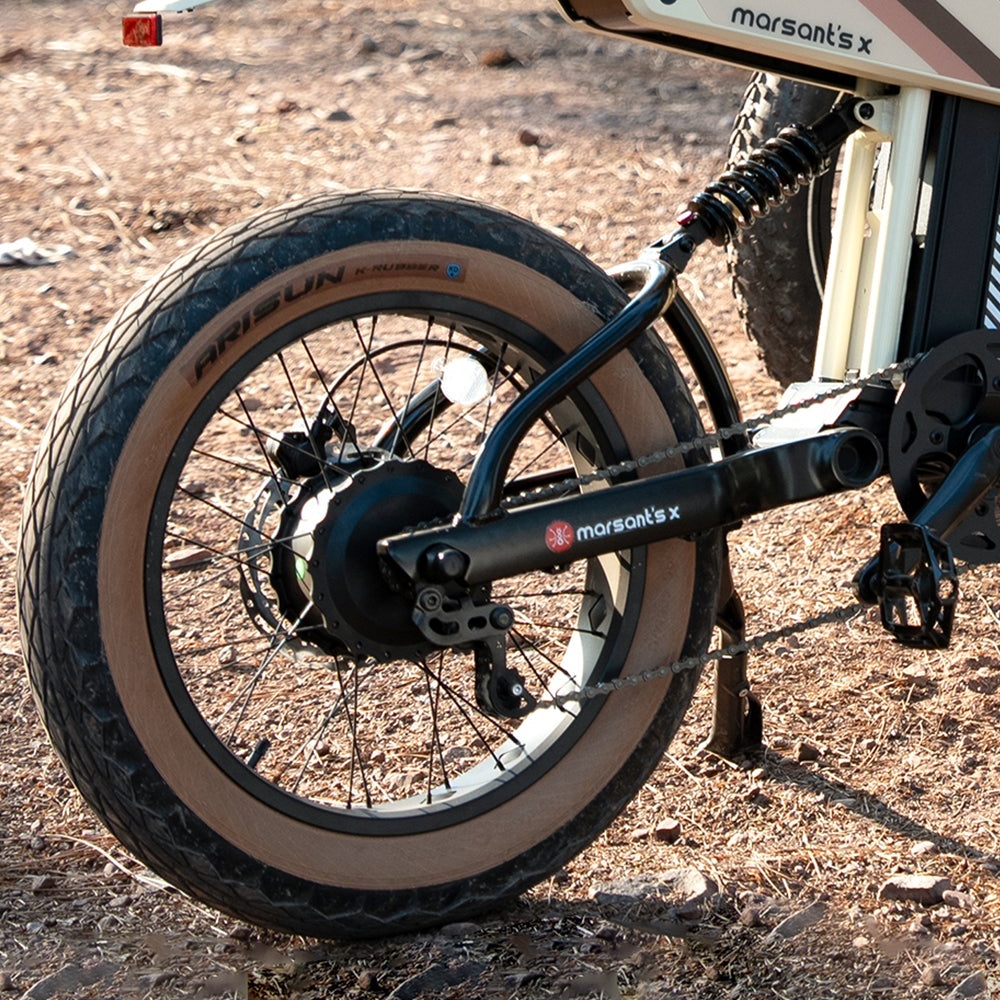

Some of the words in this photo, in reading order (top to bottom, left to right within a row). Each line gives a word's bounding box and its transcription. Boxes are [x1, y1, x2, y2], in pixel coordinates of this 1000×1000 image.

[731, 7, 853, 50] marsant's
[195, 265, 346, 382] ARISUN
[576, 506, 667, 541] marsant's
